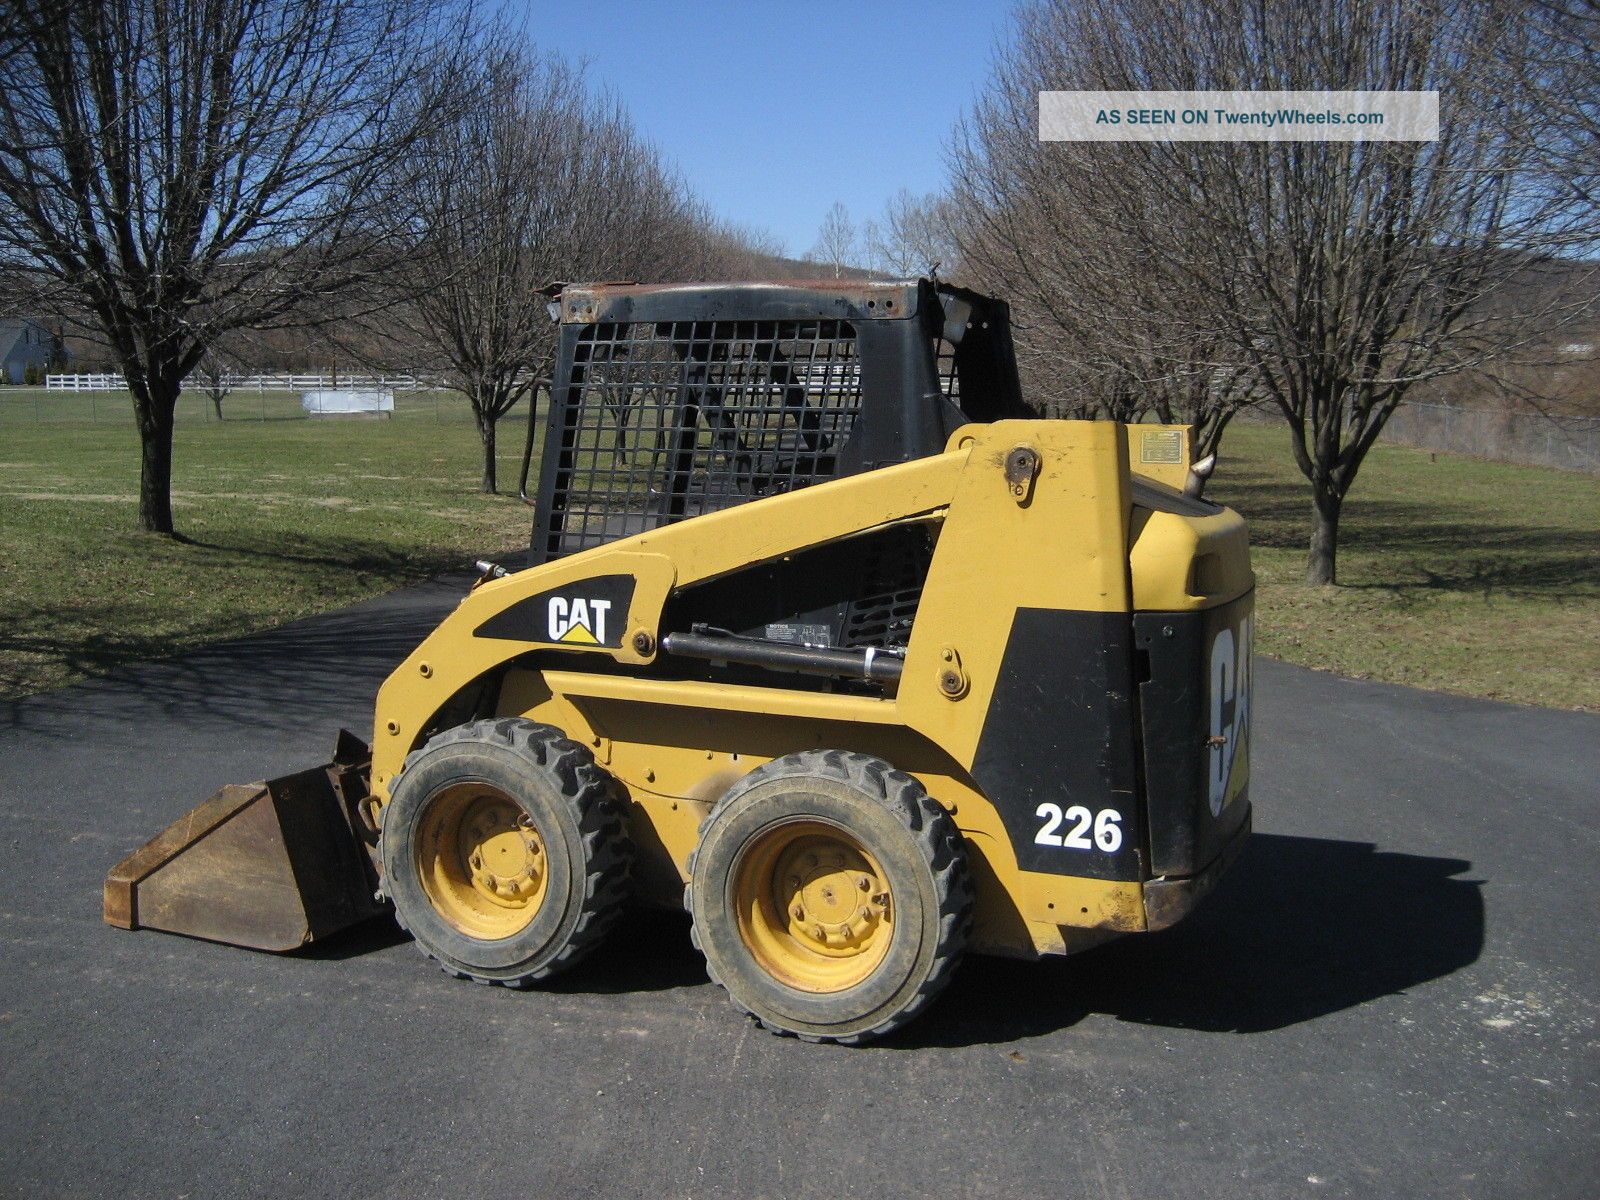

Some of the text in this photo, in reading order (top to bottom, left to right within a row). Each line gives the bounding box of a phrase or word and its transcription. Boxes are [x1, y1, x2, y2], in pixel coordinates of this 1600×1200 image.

[548, 596, 611, 644] CAT
[1208, 610, 1253, 818] CA
[1034, 802, 1122, 852] 226
